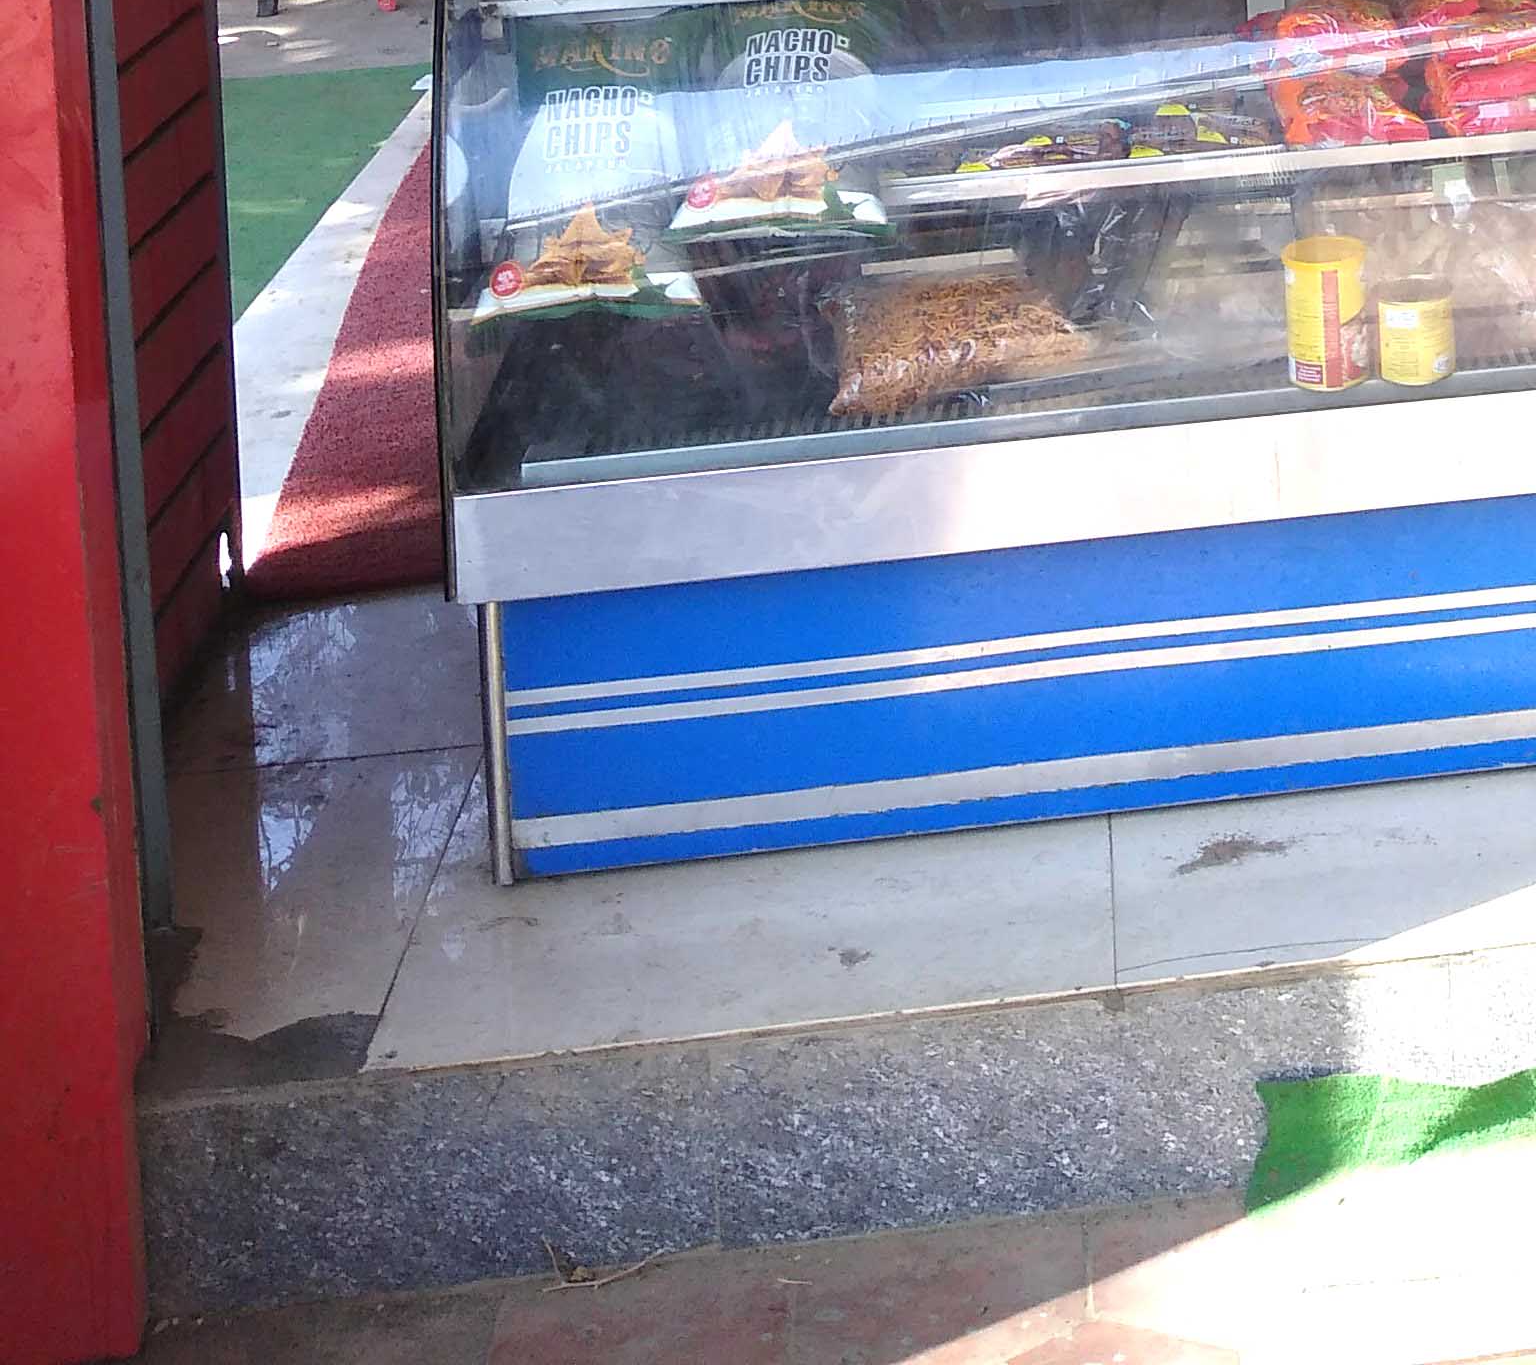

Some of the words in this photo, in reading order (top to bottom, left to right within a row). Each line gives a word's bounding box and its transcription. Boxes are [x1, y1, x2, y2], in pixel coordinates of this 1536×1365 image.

[746, 28, 835, 57] NACHO
[744, 54, 830, 88] CHIPS
[546, 85, 639, 122] NACHO
[543, 120, 632, 161] CHIPS
